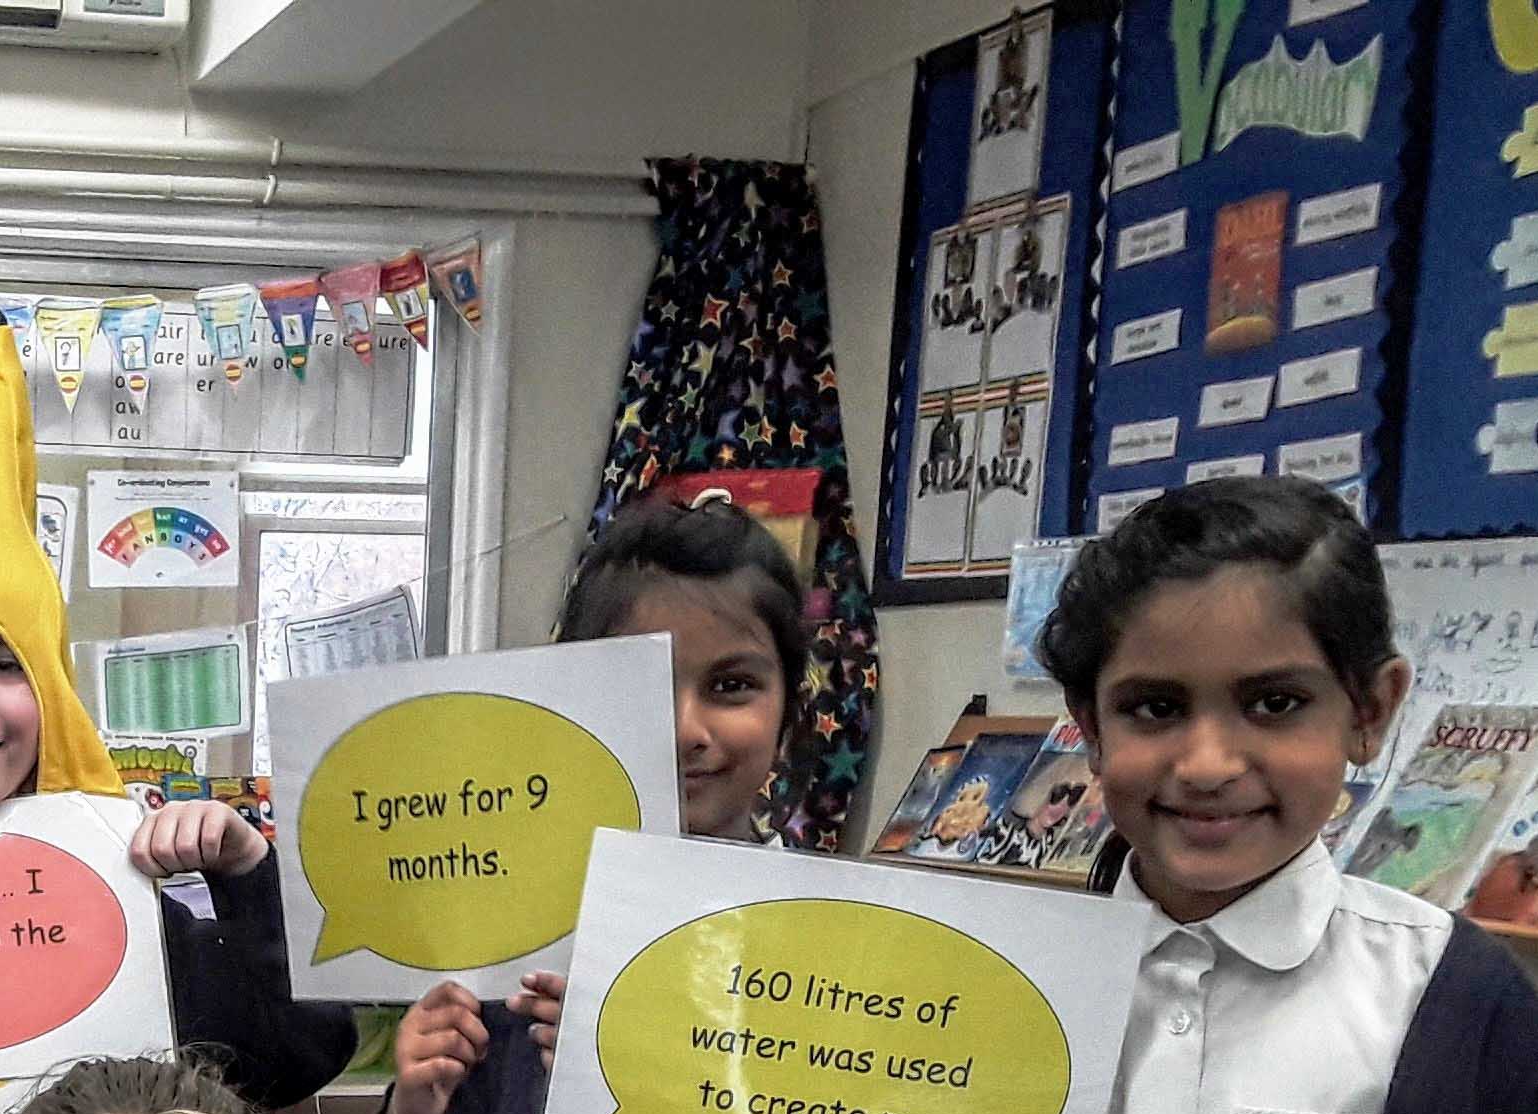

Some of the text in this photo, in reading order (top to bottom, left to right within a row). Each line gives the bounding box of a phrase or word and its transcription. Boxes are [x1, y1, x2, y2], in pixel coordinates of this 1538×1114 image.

[153, 352, 184, 366] are
[379, 337, 408, 351] ure
[197, 379, 214, 393] er
[118, 426, 142, 440] au
[351, 773, 550, 831] I grew for 9
[388, 841, 510, 882] months.
[27, 868, 45, 896] I
[10, 919, 68, 949] the
[726, 964, 960, 1029] 160 litres of
[691, 1025, 974, 1089] water was used
[699, 1079, 735, 1112] to
